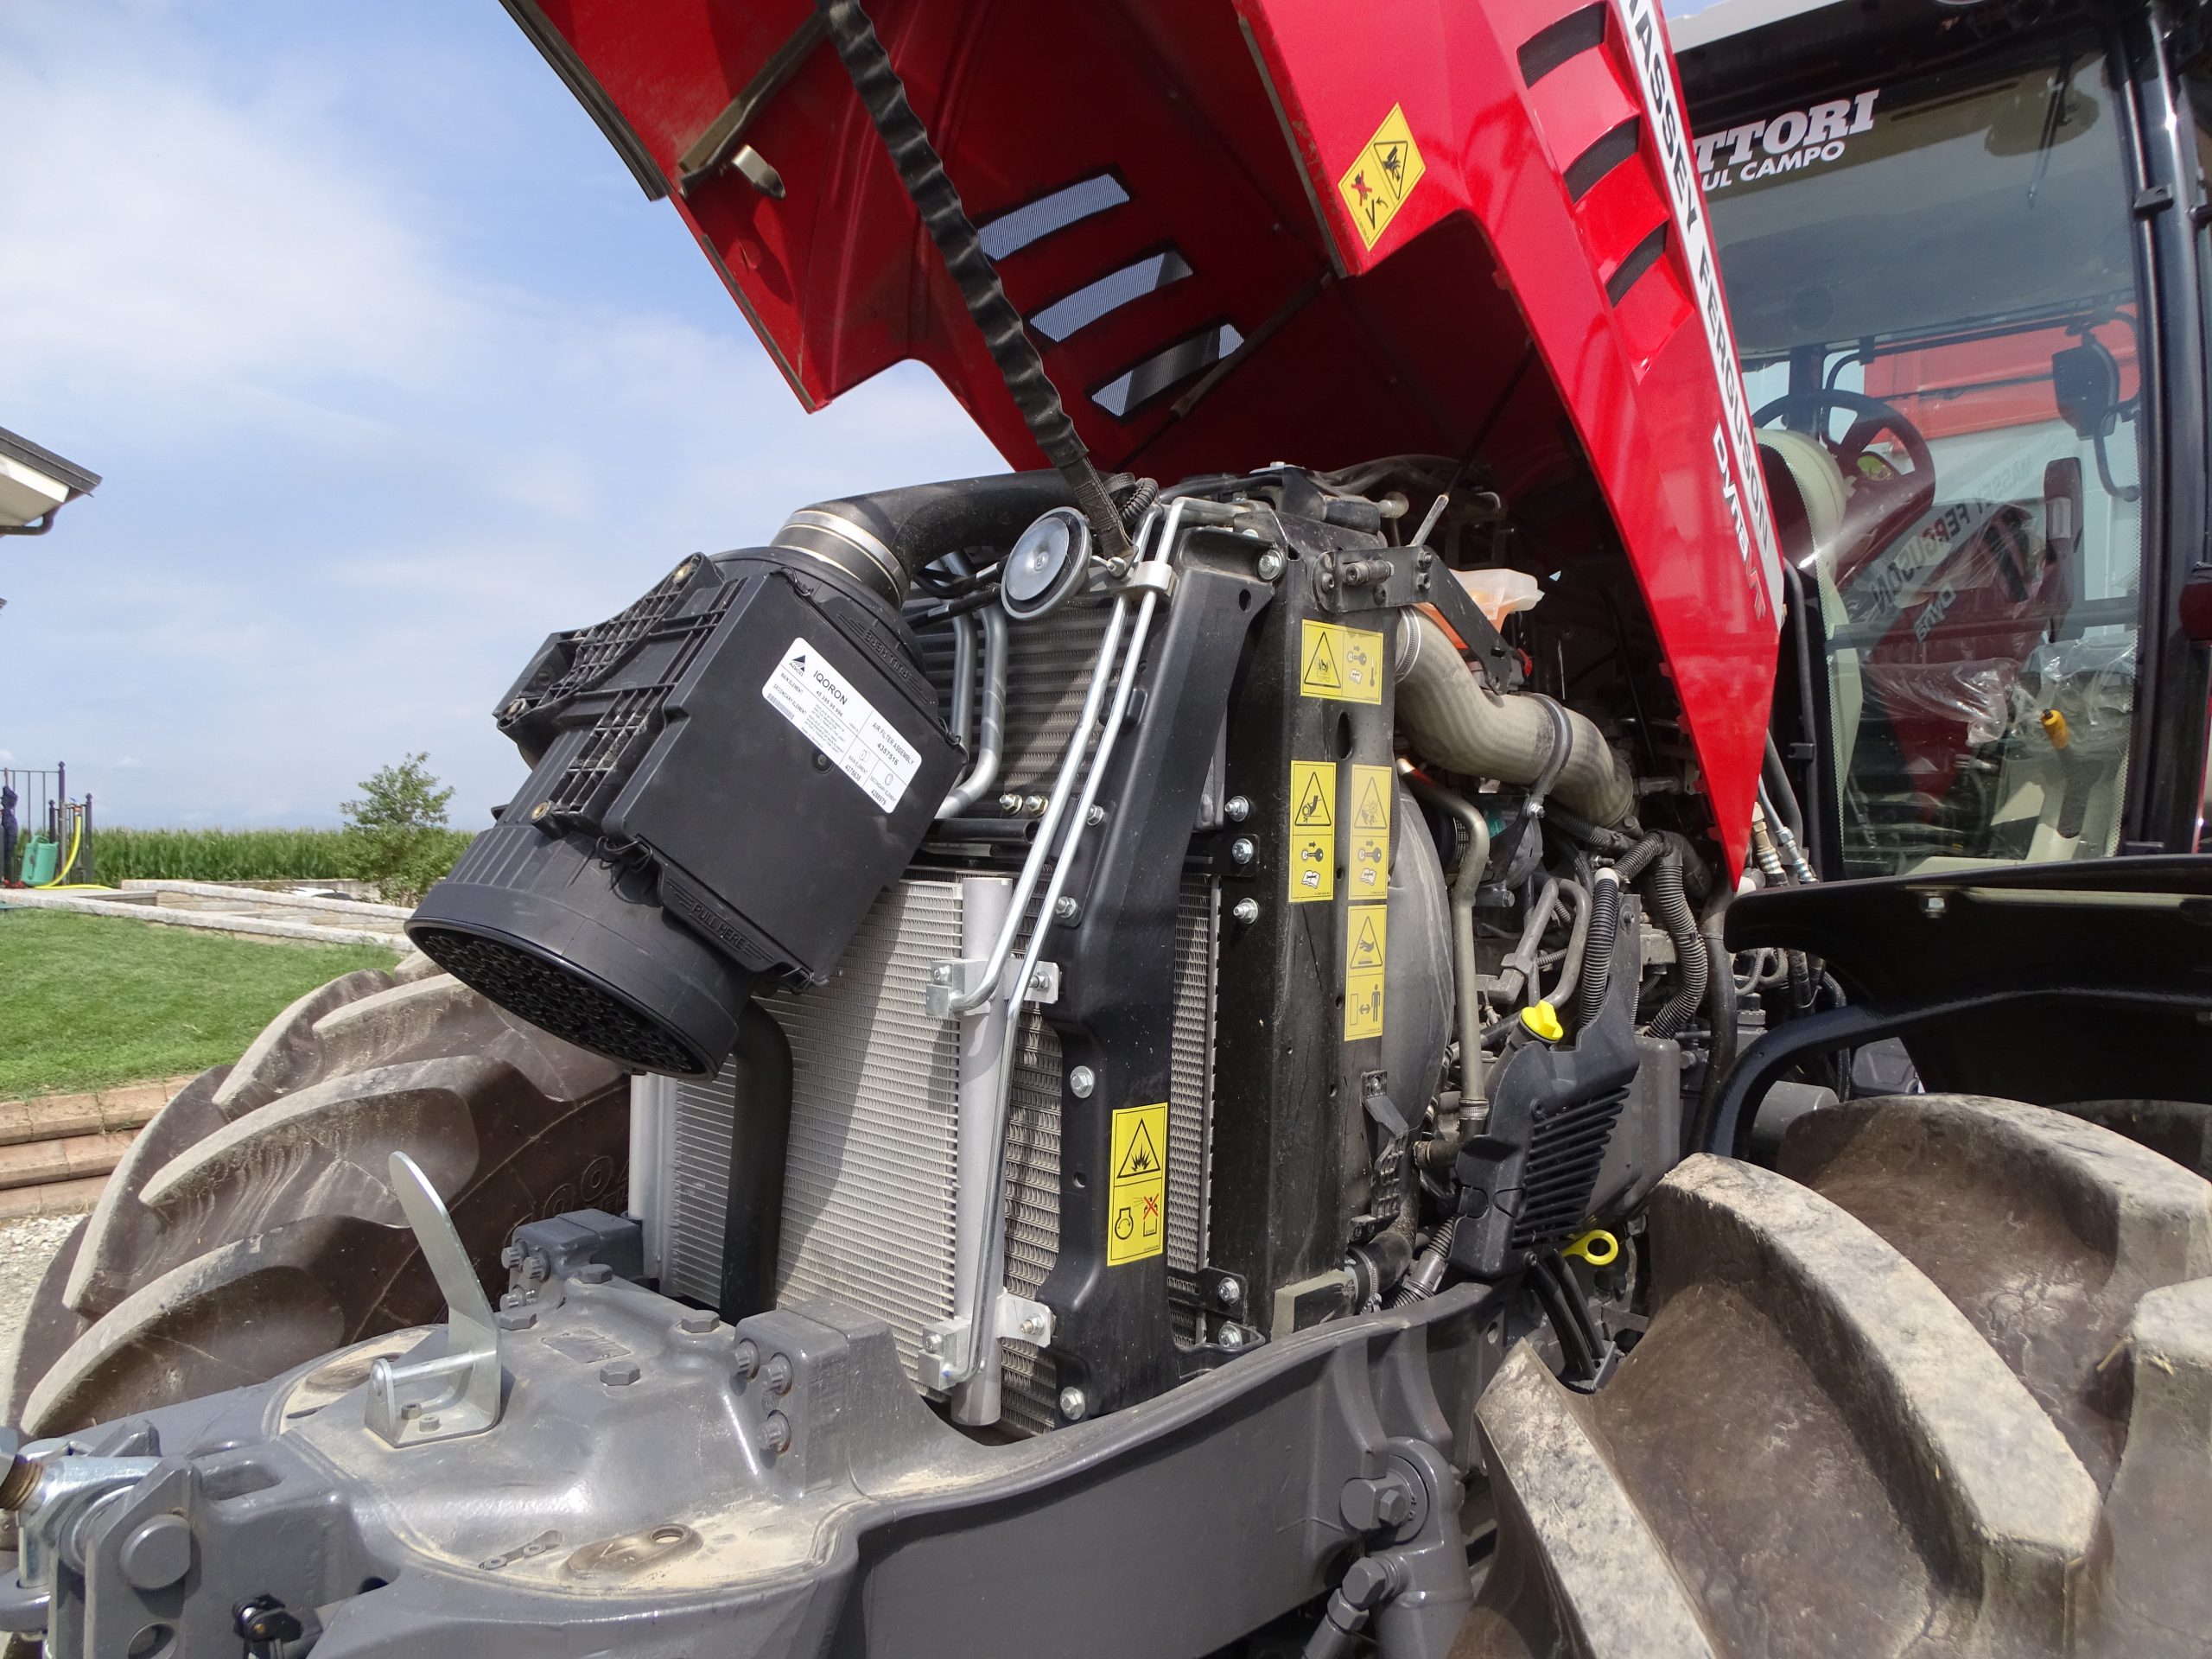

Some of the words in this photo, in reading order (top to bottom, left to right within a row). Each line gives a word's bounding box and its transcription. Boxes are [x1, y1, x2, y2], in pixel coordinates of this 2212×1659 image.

[1739, 140, 1846, 181] CAMPO
[1629, 0, 1698, 235] ASSEY
[1699, 245, 1768, 553] FERGUSON
[788, 660, 804, 677] AGCO
[812, 669, 848, 706] IQORON
[871, 721, 881, 733] AIR
[878, 728, 894, 746] FILTER
[892, 741, 915, 766] ASSEMBLY
[875, 741, 899, 766] 4357516
[690, 901, 717, 927] PULL
[714, 921, 747, 950] HERE
